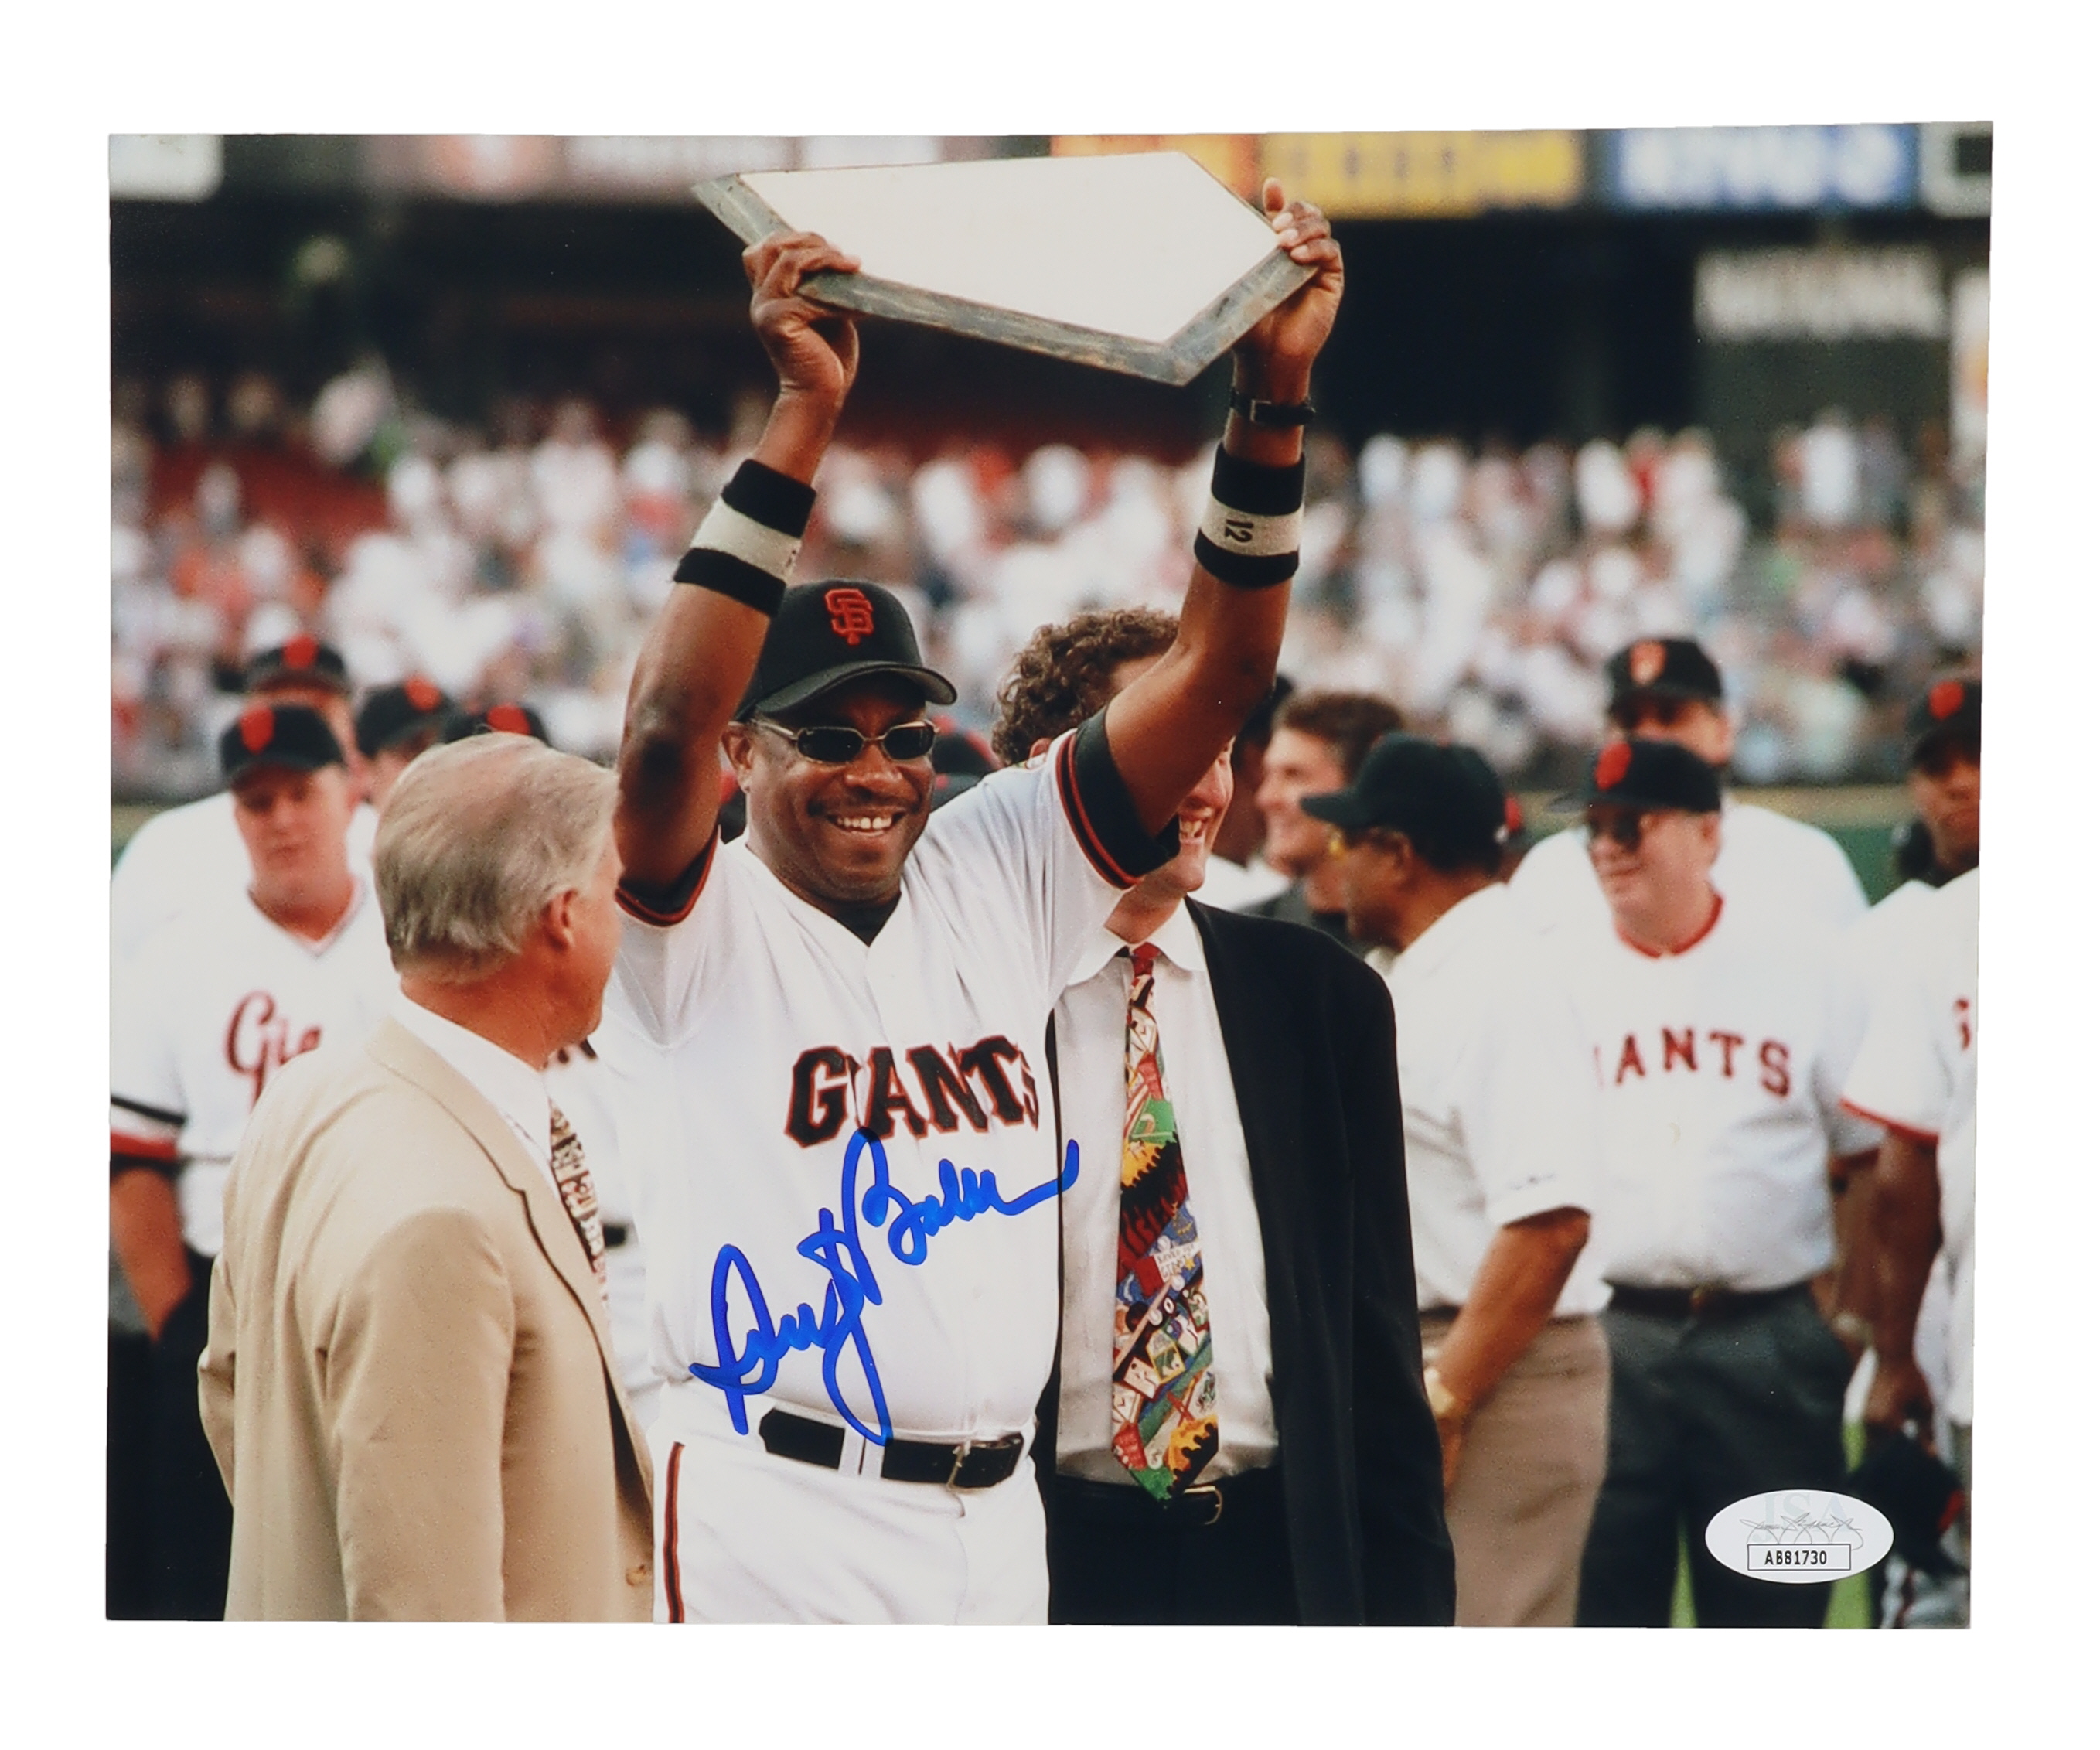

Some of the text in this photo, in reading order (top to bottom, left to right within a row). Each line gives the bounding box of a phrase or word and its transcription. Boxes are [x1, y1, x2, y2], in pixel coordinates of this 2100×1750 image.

[1225, 519, 1254, 543] 12
[824, 588, 874, 645] SF
[1594, 1027, 1792, 1098] ANTS
[1752, 1493, 1853, 1543] JSA
[1764, 1550, 1827, 1565] AB81730
